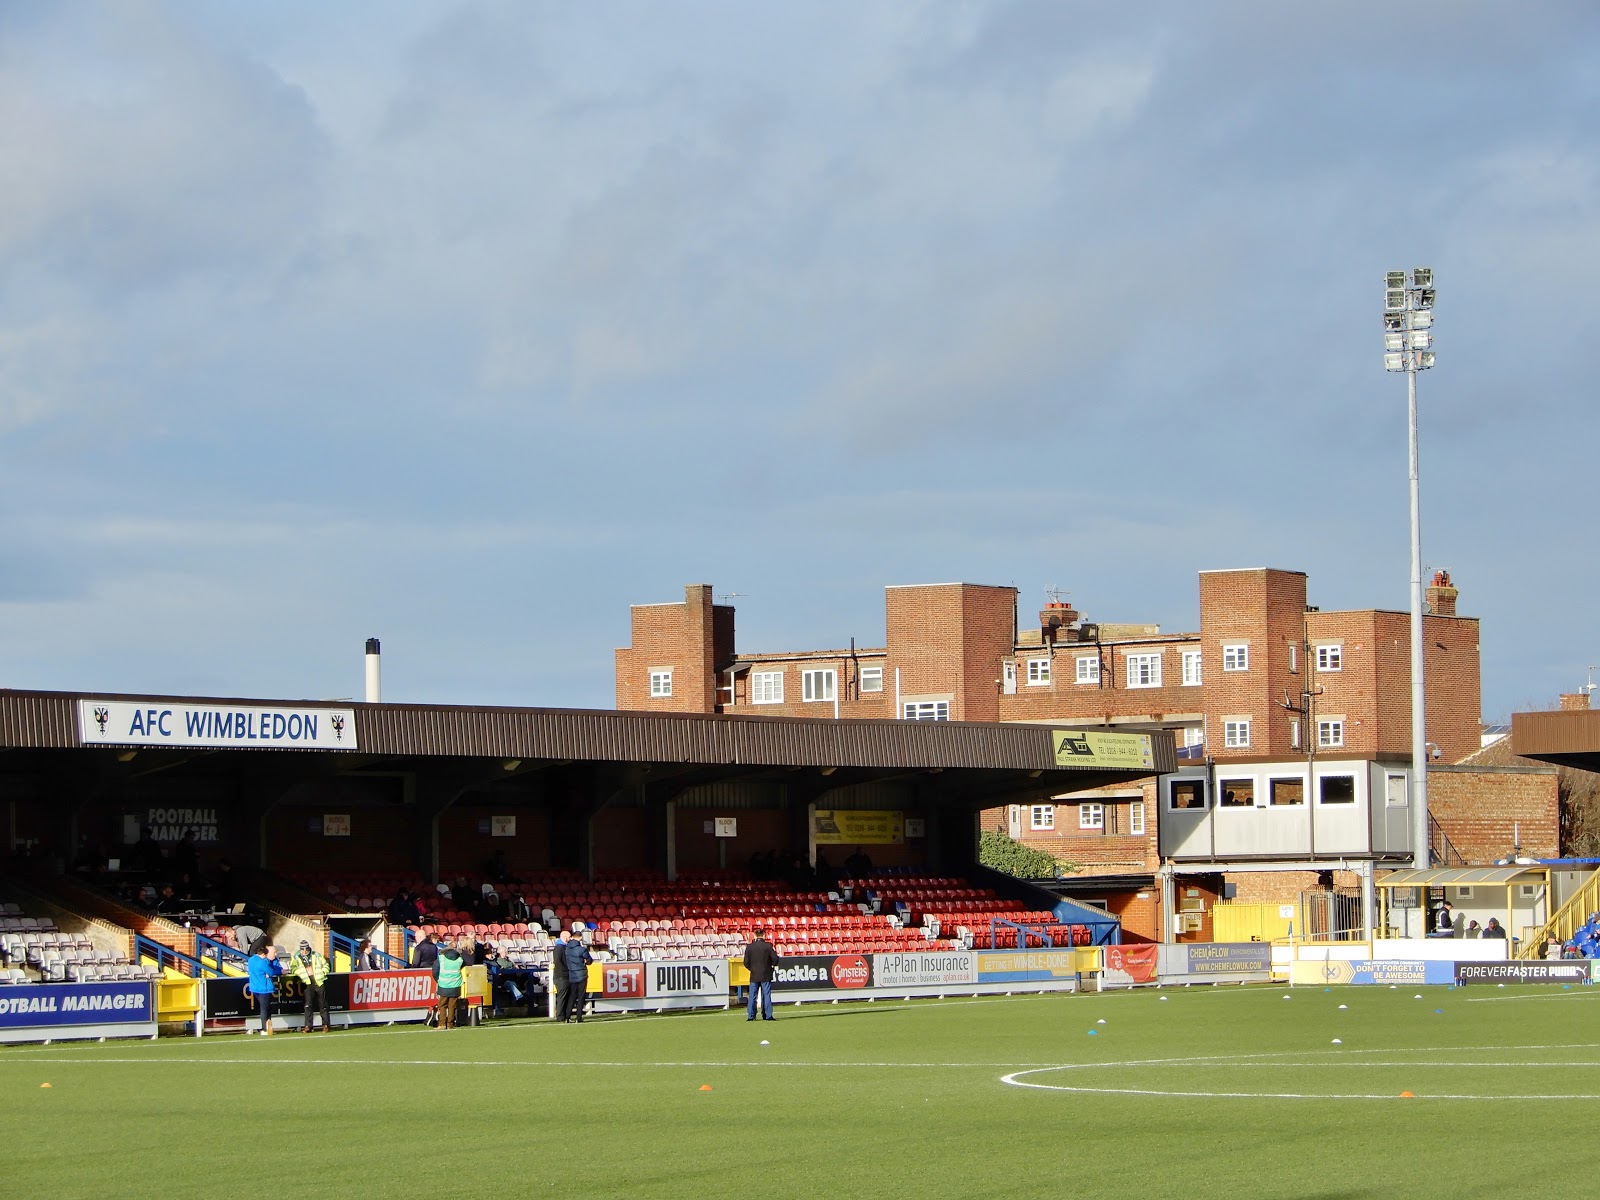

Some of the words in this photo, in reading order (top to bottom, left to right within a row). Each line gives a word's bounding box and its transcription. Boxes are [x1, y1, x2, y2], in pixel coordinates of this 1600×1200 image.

[129, 709, 172, 736] AFC
[185, 711, 318, 740] WIMBLEDON
[148, 808, 217, 824] FOOTBALL
[335, 824, 340, 834] J
[501, 824, 506, 833] K
[724, 826, 728, 834] L
[912, 826, 918, 834] M
[883, 954, 917, 973] A-Plan
[921, 956, 969, 972] Insurance
[984, 961, 1006, 970] GETTING
[1008, 961, 1013, 969] IT
[1013, 954, 1069, 969] WIMBLE-DONE!
[1195, 961, 1262, 971] WWW.CHEMFLOWUK.COM
[606, 968, 640, 993] BET
[656, 965, 701, 991] PUMA
[771, 965, 818, 982] Tackle
[820, 967, 828, 981] a
[883, 976, 898, 984] motor
[902, 974, 916, 982] home
[920, 974, 940, 982] business
[943, 972, 970, 983] aplan.co.uk
[62, 994, 145, 1012] MANAGER
[243, 980, 304, 1010] qest
